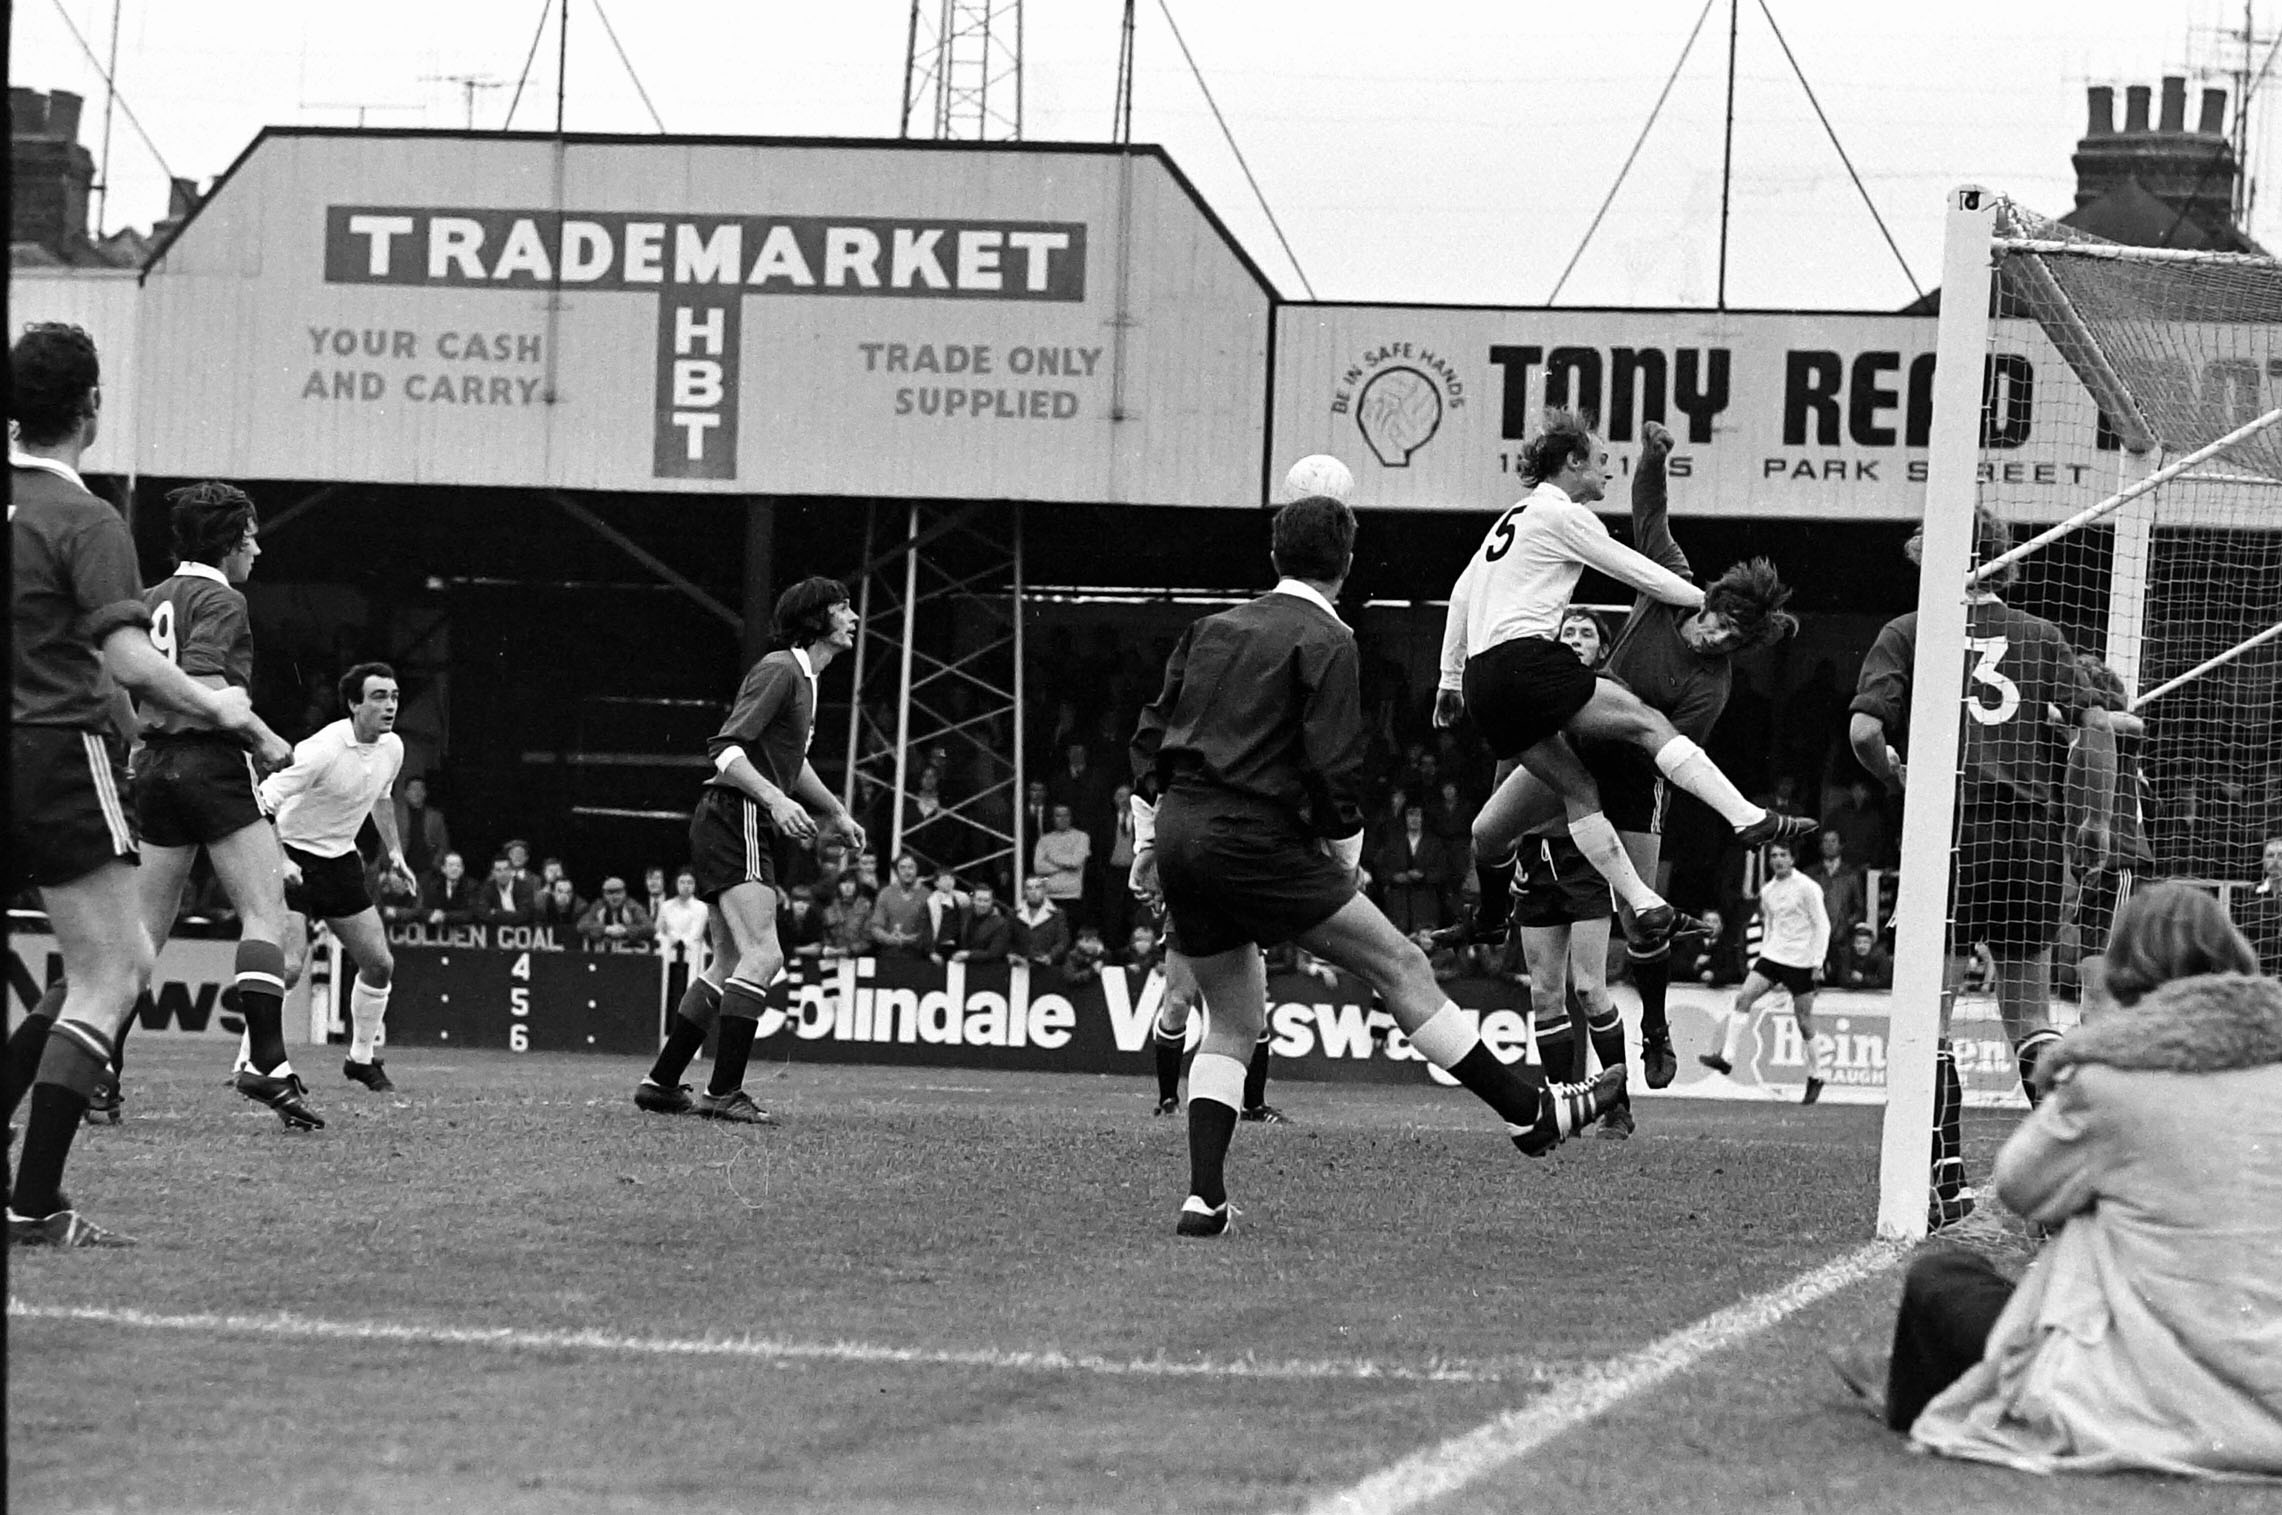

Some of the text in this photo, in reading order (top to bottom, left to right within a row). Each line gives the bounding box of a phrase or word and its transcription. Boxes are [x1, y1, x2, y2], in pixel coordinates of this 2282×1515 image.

[350, 216, 1069, 291] TRADEMARKET
[309, 328, 542, 362] YOUR CASH
[858, 343, 1102, 376] TRADE ONLY
[302, 371, 542, 405] AND CARRY
[1331, 342, 1465, 414] BE IN SAFE HANDS
[894, 388, 1079, 419] SUPPLIED
[1764, 458, 2092, 485] PARK SREET
[1485, 505, 1528, 562] 5
[150, 600, 177, 666] 9
[1965, 635, 2021, 726] 3
[498, 925, 564, 951] GOAL
[511, 953, 530, 981] 4
[510, 988, 529, 1016] 5
[755, 956, 1077, 1050] olindale
[509, 1024, 529, 1052] 6
[1769, 1015, 2012, 1073] Heinen
